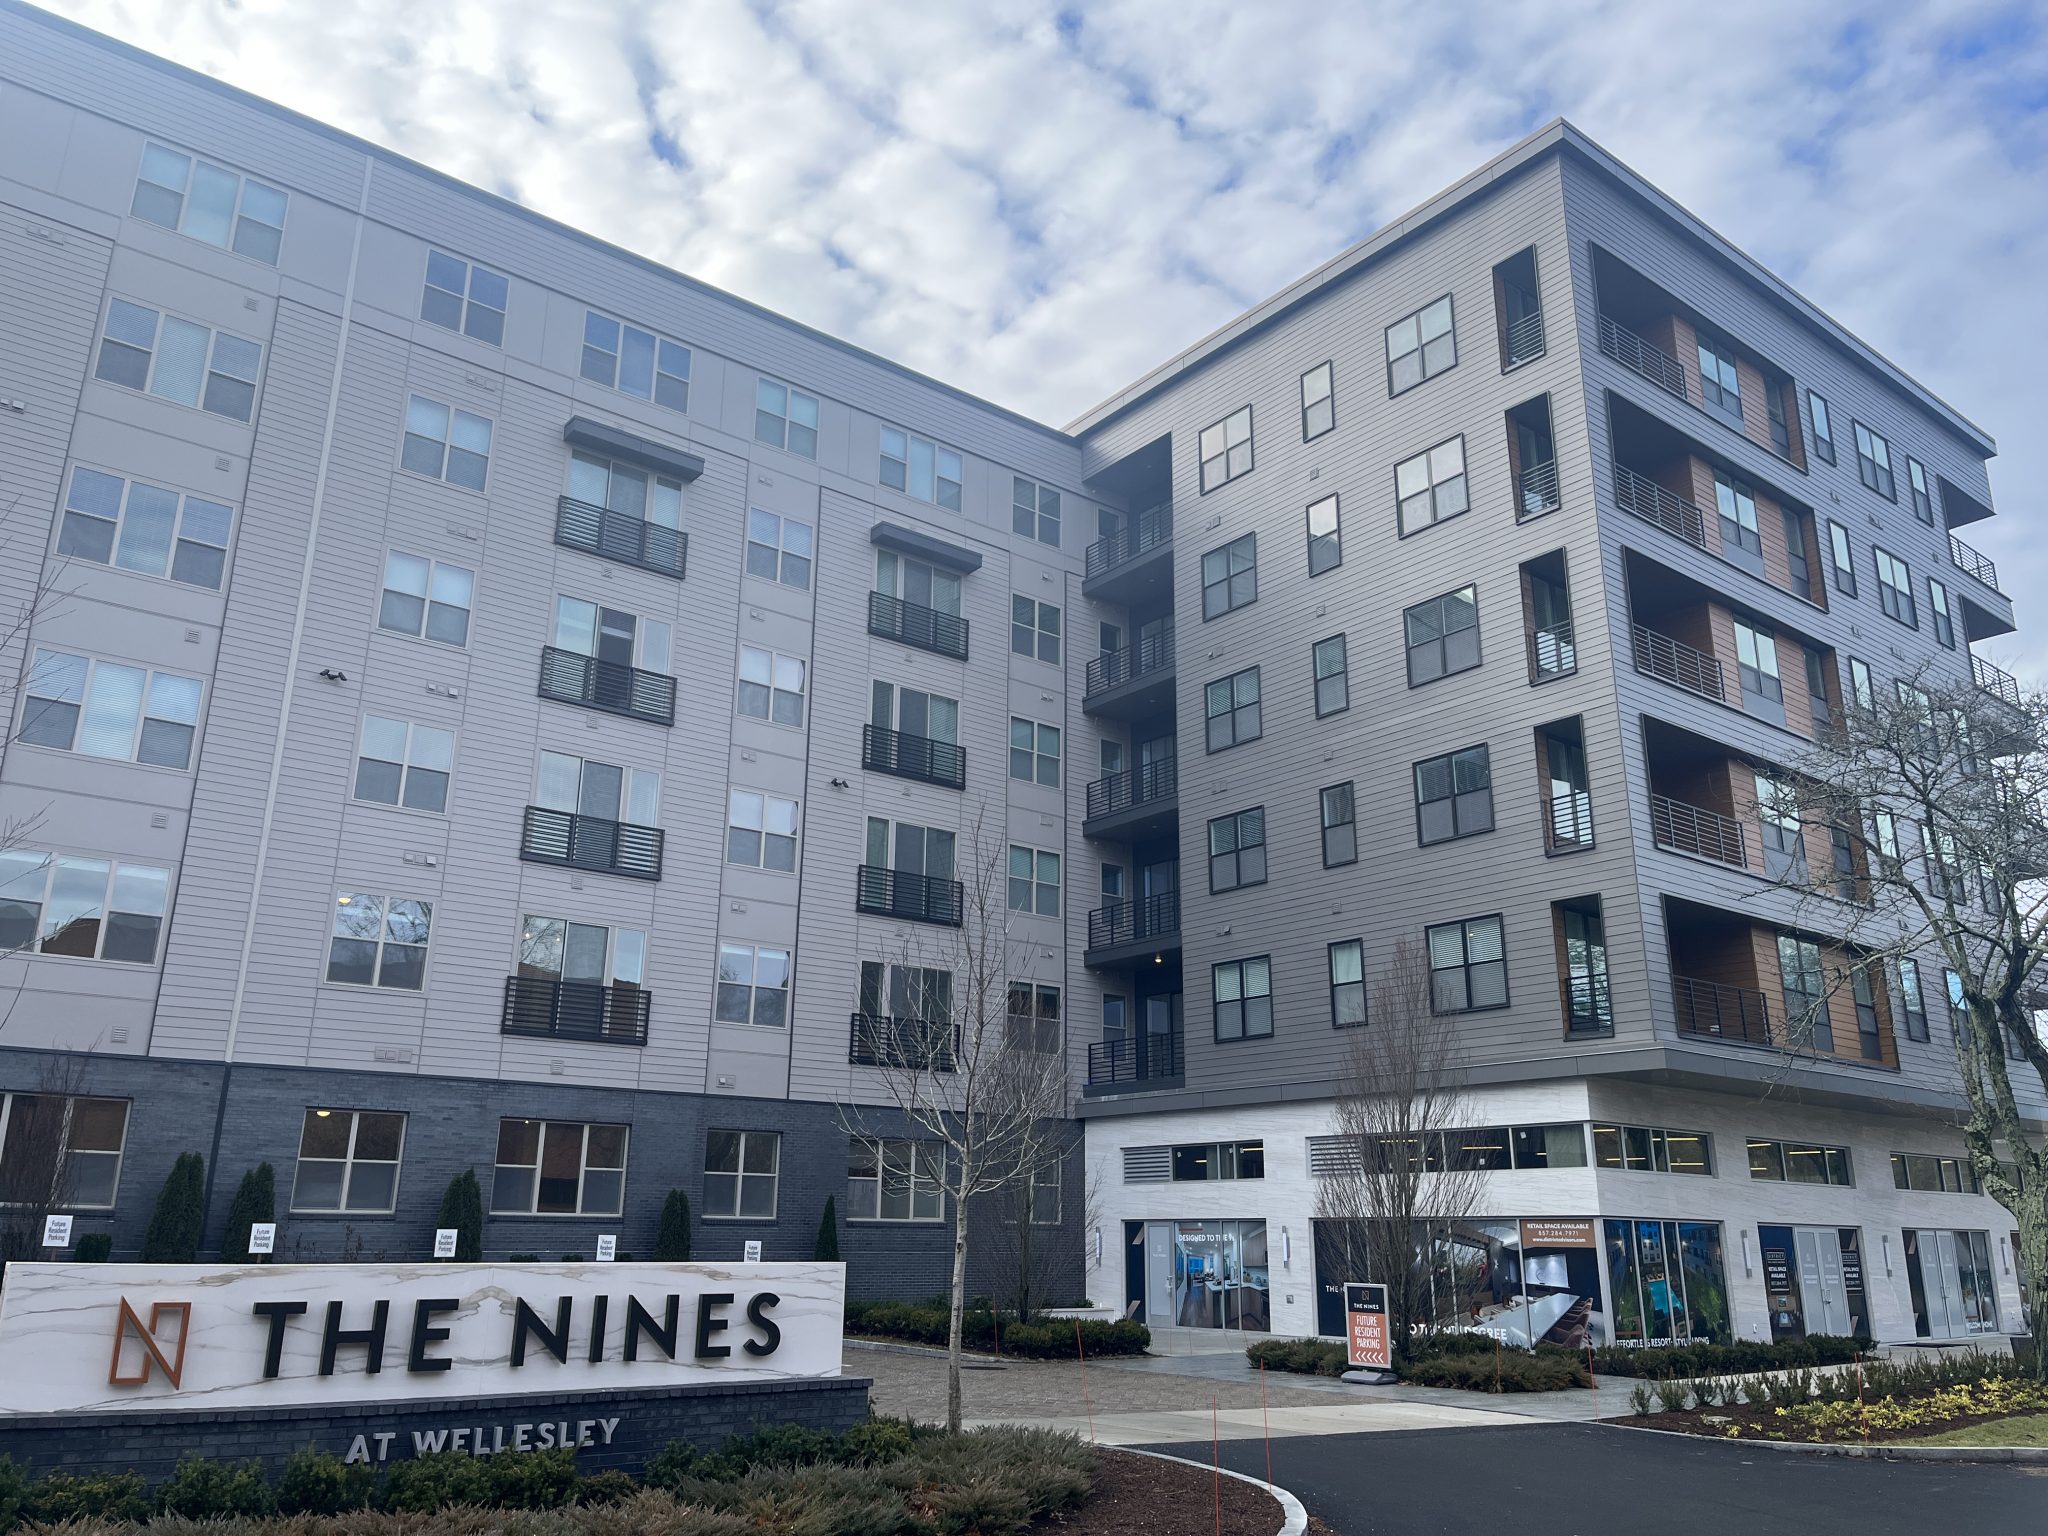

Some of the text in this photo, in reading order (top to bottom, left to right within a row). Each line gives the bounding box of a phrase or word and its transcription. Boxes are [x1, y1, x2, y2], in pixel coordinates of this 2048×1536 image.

[48, 1234, 65, 1242] Parking
[1178, 1234, 1206, 1242] DESIGNED
[1206, 1234, 1215, 1242] TO
[254, 1241, 270, 1249] Parking
[1325, 1285, 1339, 1293] THE
[1356, 1315, 1378, 1327] FUTURE
[253, 1292, 781, 1378] THE NINES
[1354, 1326, 1381, 1338] RESIDENT
[1356, 1338, 1380, 1349] PARKING
[1616, 1339, 1650, 1348] EFFORTLES
[345, 1418, 620, 1463] AT WELLESLEY
